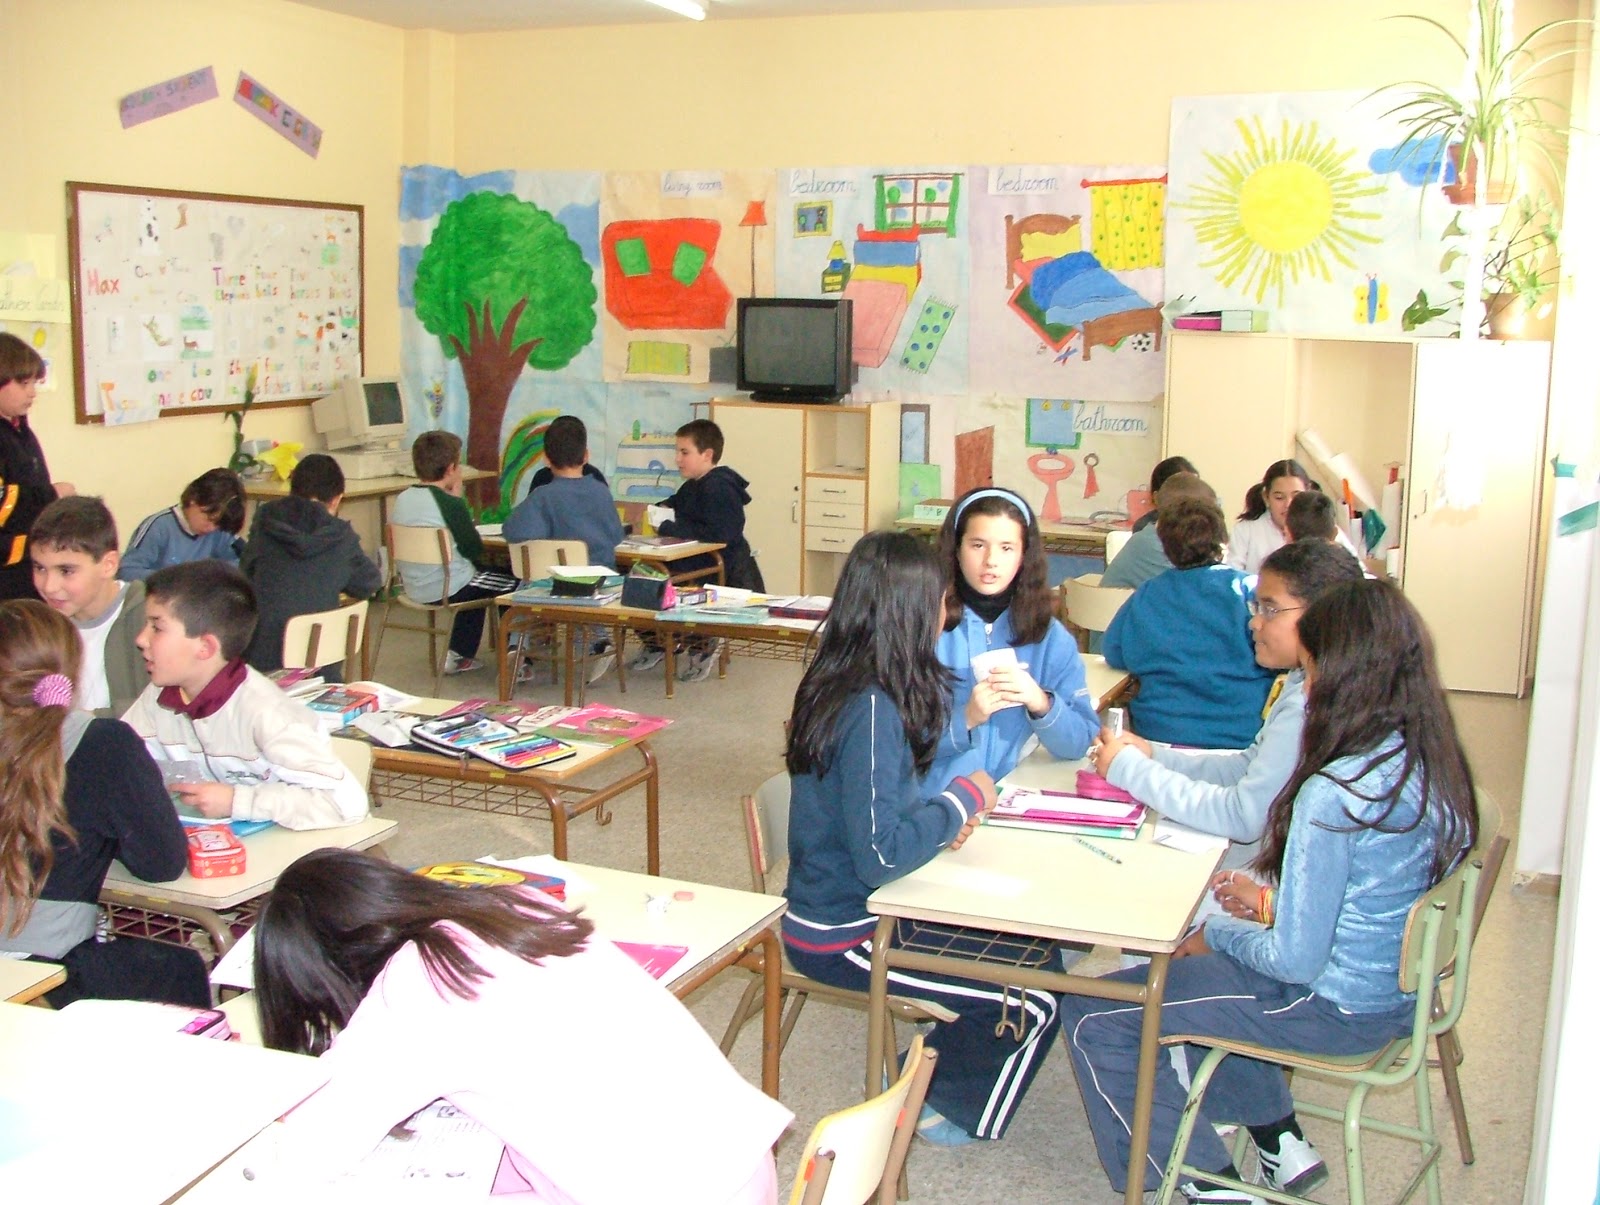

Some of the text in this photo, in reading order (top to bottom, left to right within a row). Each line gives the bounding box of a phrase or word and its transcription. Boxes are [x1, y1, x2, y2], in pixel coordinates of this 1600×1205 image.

[791, 169, 856, 193] bedroom
[997, 168, 1059, 192] bedroom
[212, 266, 246, 286] Tree
[1073, 404, 1148, 432] bathroom
